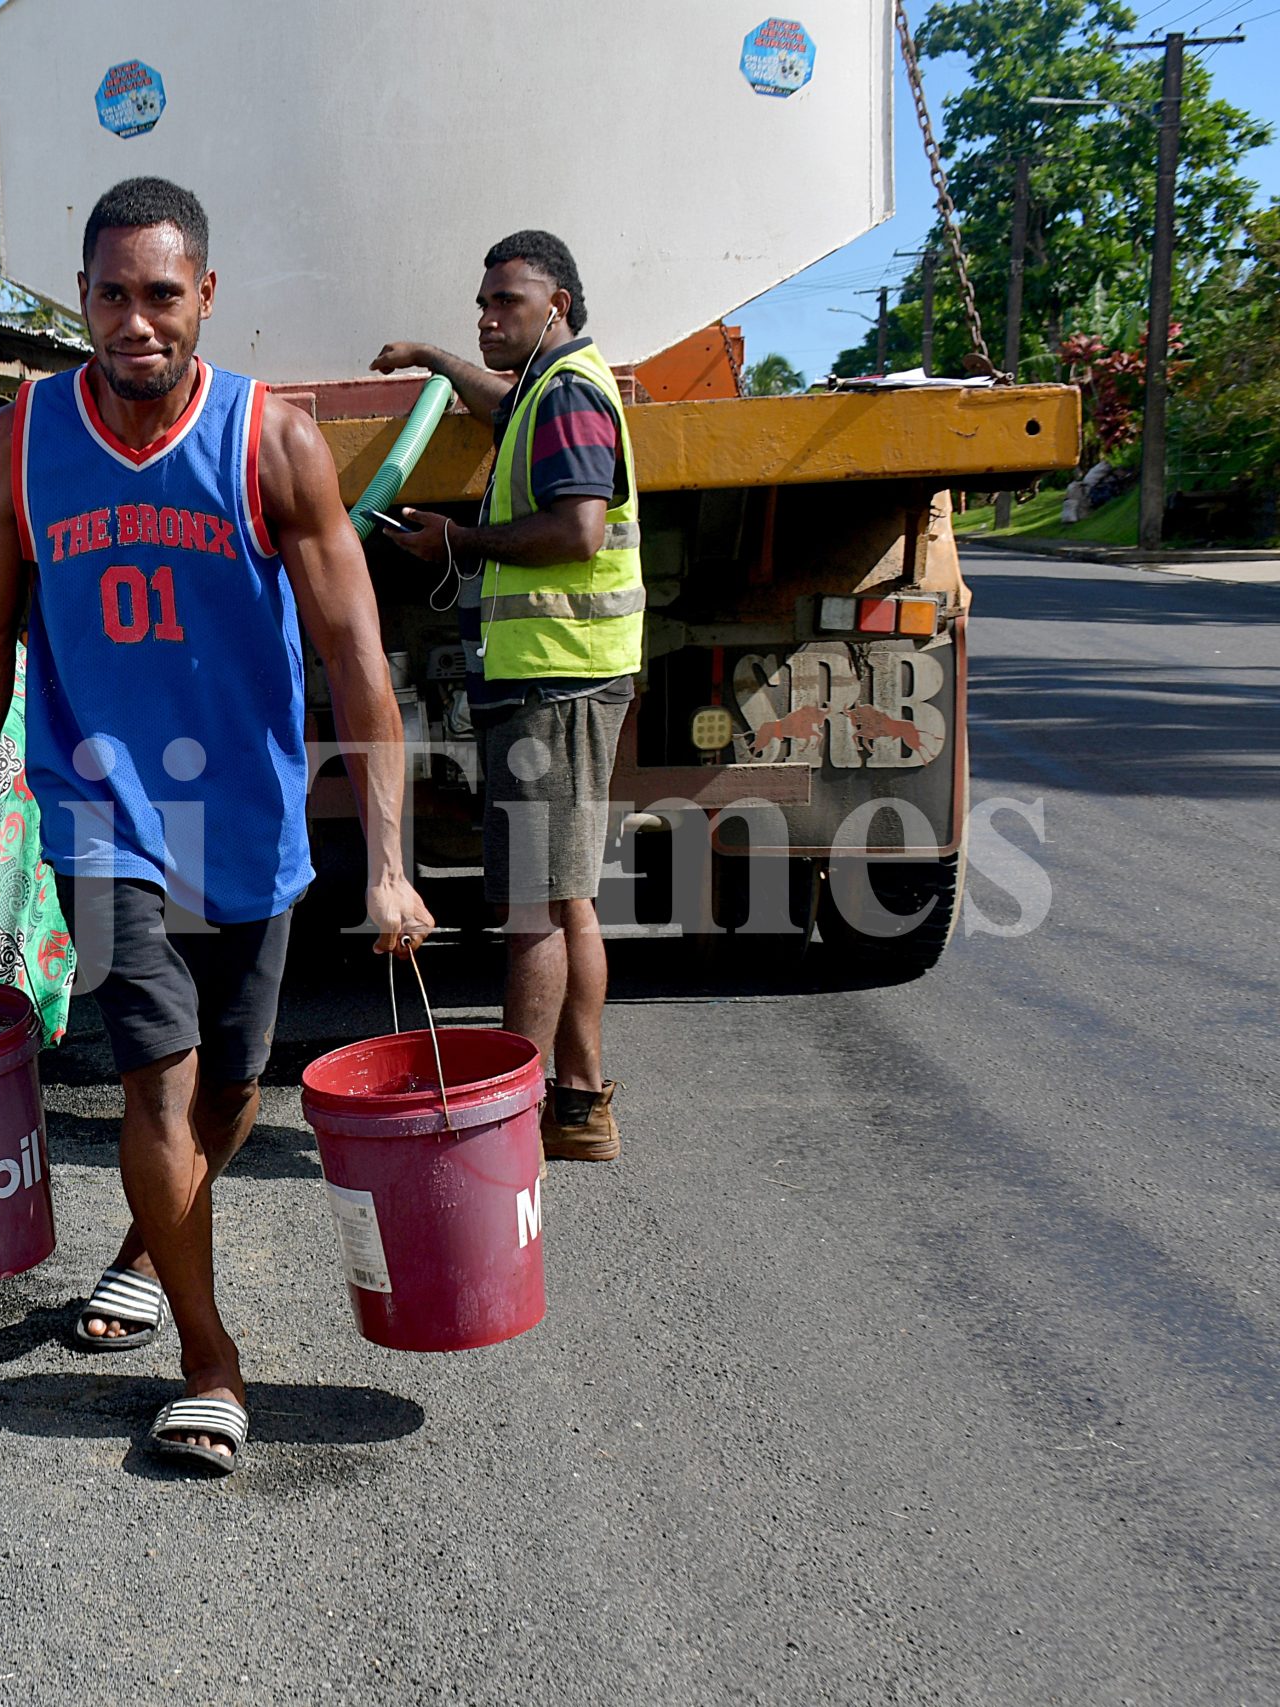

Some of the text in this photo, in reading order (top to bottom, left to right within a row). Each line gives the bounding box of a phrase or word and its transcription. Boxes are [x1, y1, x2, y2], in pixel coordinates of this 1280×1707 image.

[767, 18, 801, 31] STOP
[754, 37, 807, 52] SURVIVE
[761, 28, 804, 43] REVIVE
[105, 69, 147, 88] REVIVE
[109, 63, 139, 78] STOP
[104, 77, 152, 98] SURVIVE
[47, 503, 238, 563] THE BRONX
[99, 565, 184, 644] 01
[732, 650, 947, 769] SRB
